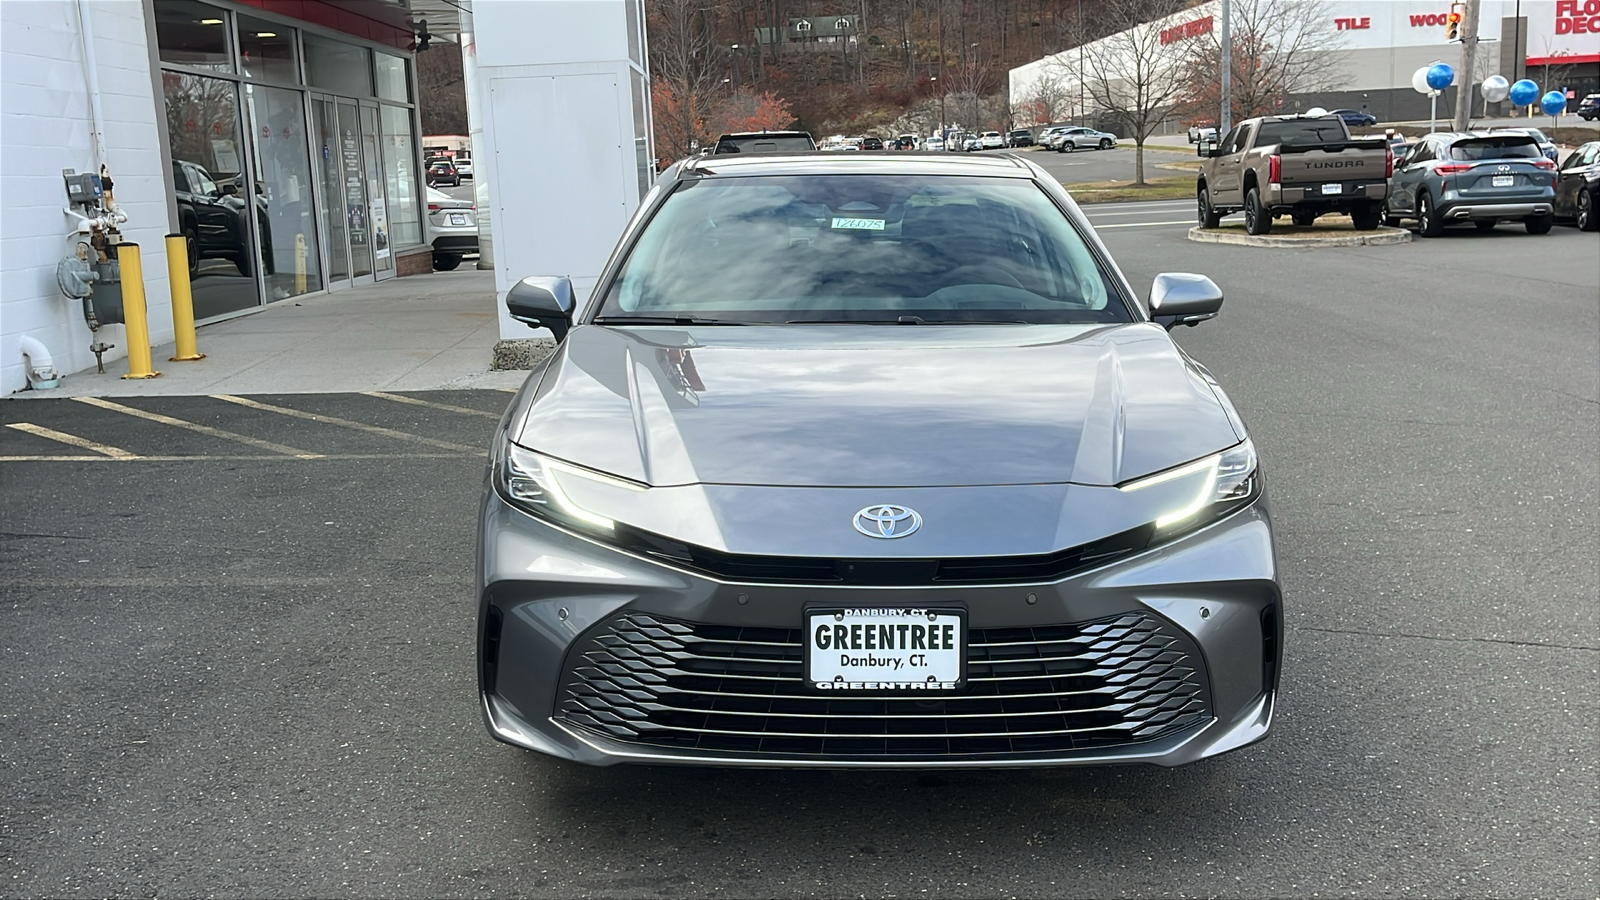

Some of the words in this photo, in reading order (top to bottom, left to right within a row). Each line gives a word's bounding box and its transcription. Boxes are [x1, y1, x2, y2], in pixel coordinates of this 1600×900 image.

[1556, 0, 1600, 17] FLO
[1334, 17, 1371, 30] TILE
[1409, 13, 1460, 27] WOO
[1304, 160, 1364, 169] TUNDRA
[844, 608, 907, 617] DANBURY,
[910, 608, 928, 617] CT
[815, 624, 954, 650] GREENTREE
[840, 653, 905, 671] Danbury,
[909, 654, 928, 667] CT.
[815, 681, 956, 690] GREENTREE
